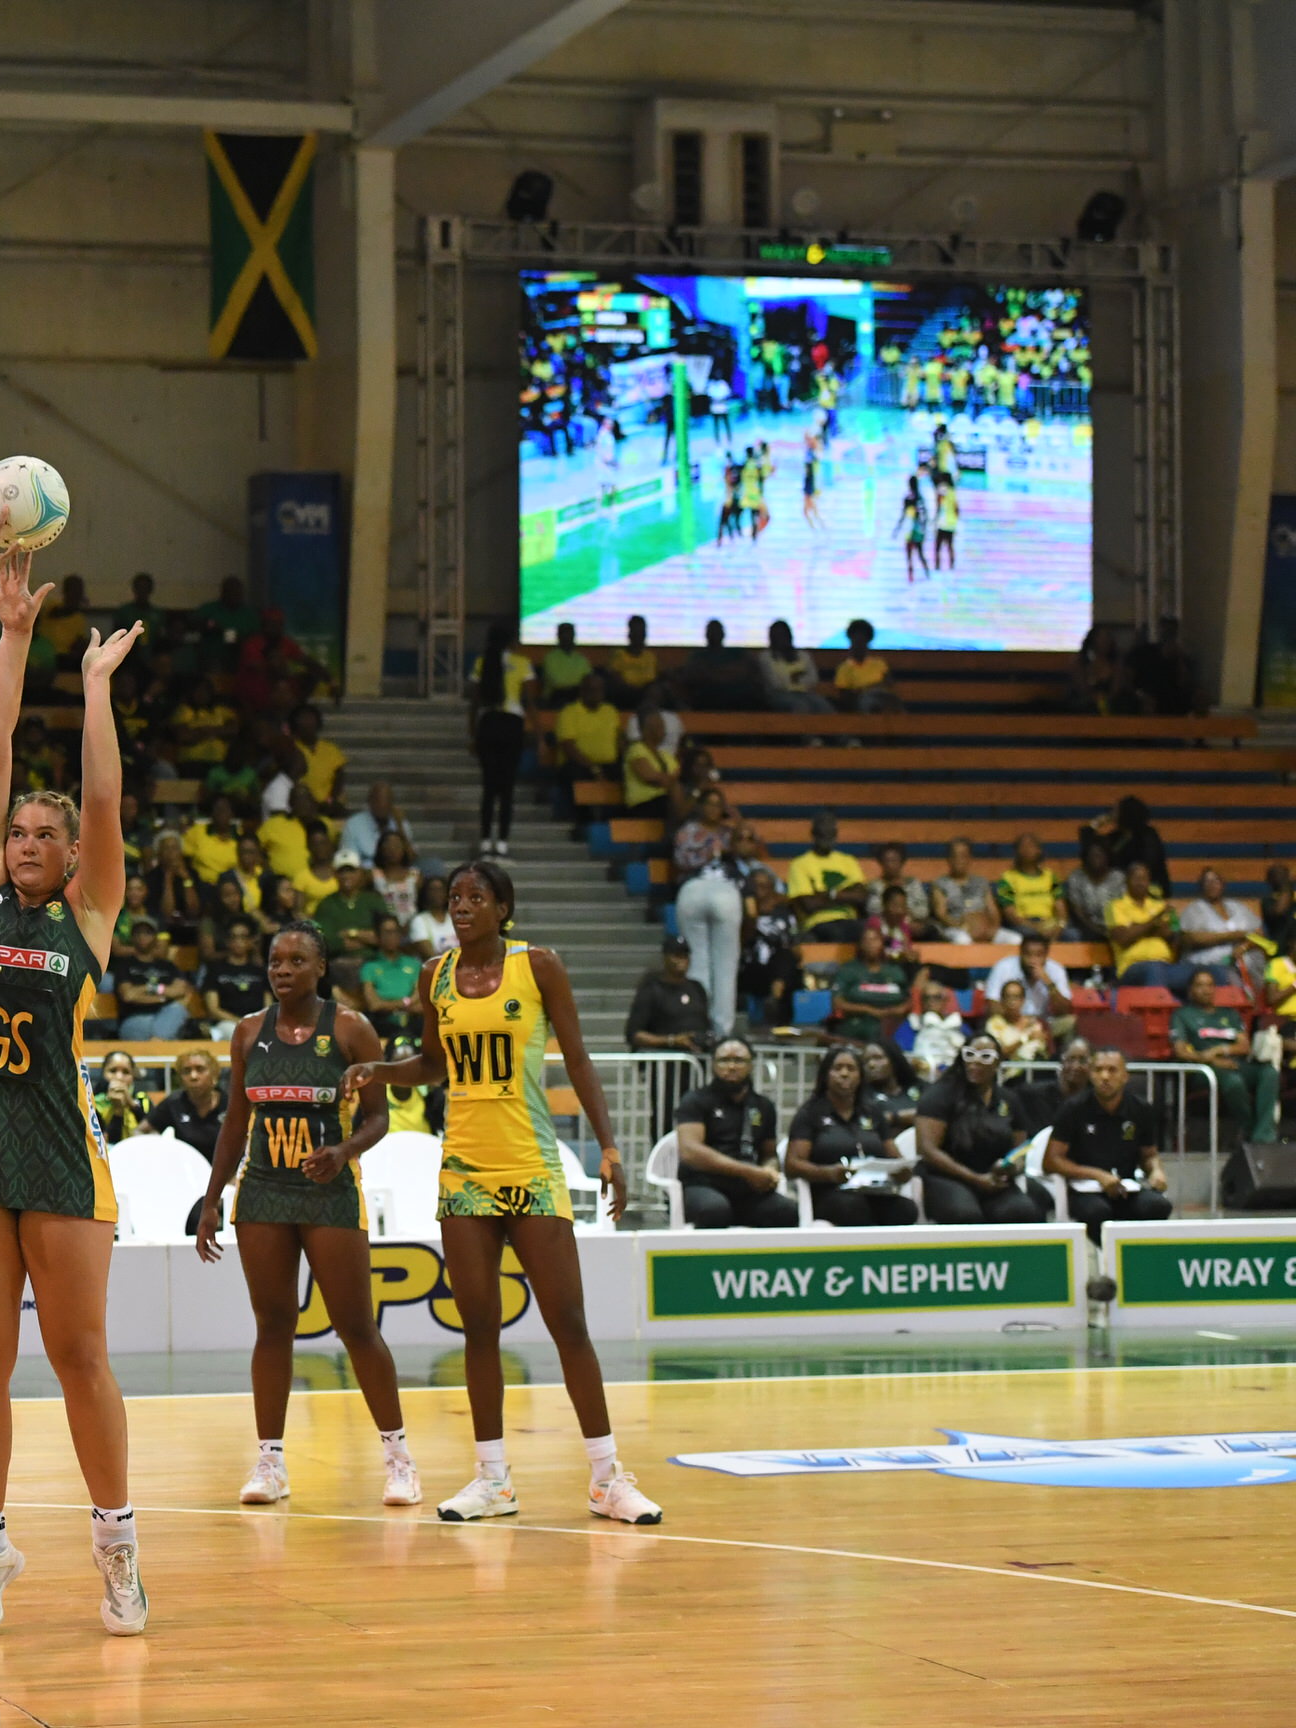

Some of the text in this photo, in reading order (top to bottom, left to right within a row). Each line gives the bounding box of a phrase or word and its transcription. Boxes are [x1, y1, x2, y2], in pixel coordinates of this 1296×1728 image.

[443, 1030, 514, 1085] WD
[255, 1088, 313, 1100] SPAR
[264, 1117, 315, 1169] WA
[712, 1261, 1009, 1299] WRAY & NEPHEW
[1178, 1257, 1275, 1288] WRAY
